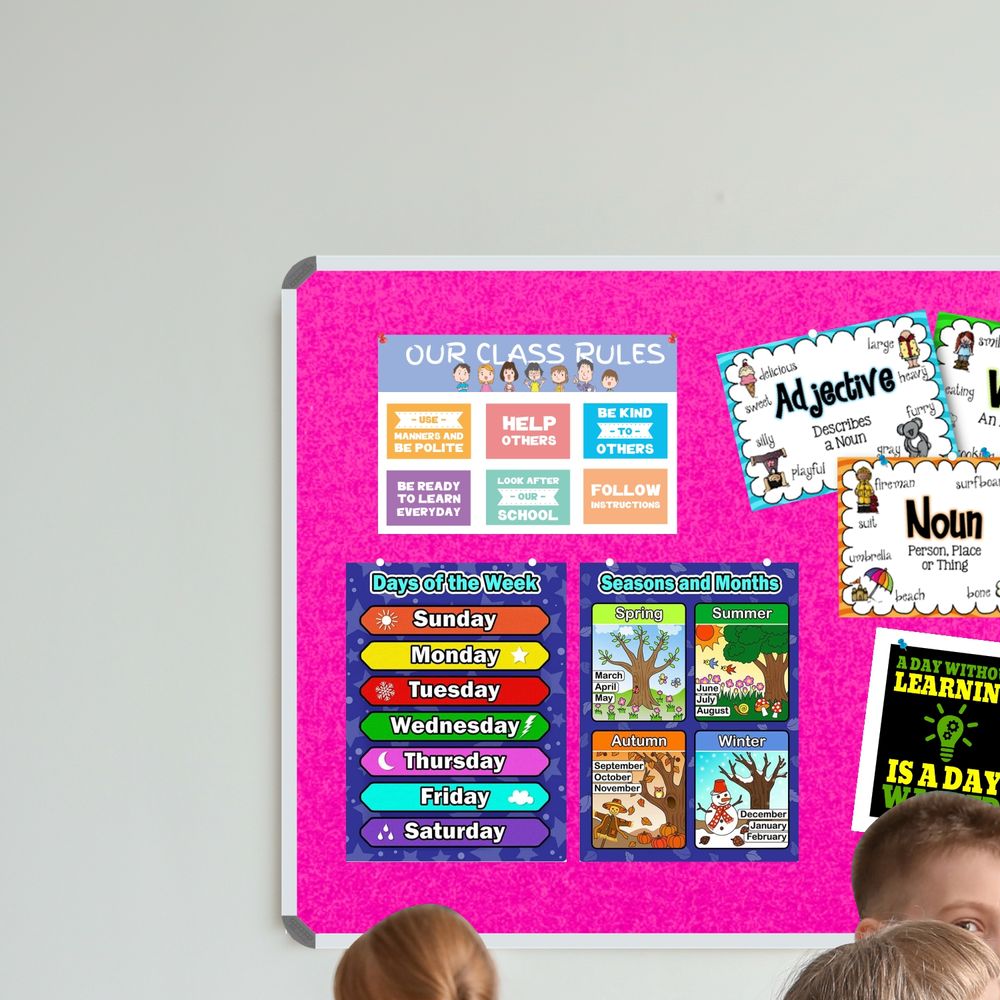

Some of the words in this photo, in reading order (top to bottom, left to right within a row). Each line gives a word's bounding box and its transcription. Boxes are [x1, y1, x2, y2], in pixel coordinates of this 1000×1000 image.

[868, 337, 894, 353] large
[405, 342, 466, 365] OUR
[477, 343, 565, 365] CLASS
[575, 342, 666, 365] RULES
[759, 362, 797, 380] delicious
[898, 368, 928, 383] heavy
[776, 367, 895, 419] Adjective
[945, 383, 975, 402] eating
[745, 397, 772, 414] sweet
[906, 403, 936, 418] furry
[597, 408, 617, 418] BE
[619, 408, 653, 418] KIND
[978, 412, 997, 426] An
[419, 416, 438, 424] USE
[502, 416, 557, 431] HELP
[617, 427, 632, 436] TO
[812, 416, 872, 437] Describes
[394, 432, 441, 441] MANNERS
[443, 432, 464, 441] AND
[501, 435, 557, 446] OTHERS
[756, 433, 774, 448] silly
[825, 442, 833, 451] a
[836, 433, 867, 449] Noun
[394, 443, 413, 453] BE
[415, 443, 464, 453] POLITE
[596, 443, 654, 455] OTHERS
[792, 463, 826, 480] playful
[397, 481, 415, 491] BE
[417, 481, 460, 491] READY
[497, 477, 524, 485] LOOK
[526, 477, 559, 485] AFTER
[875, 478, 915, 490] fireman
[518, 492, 538, 501] OUR
[591, 484, 661, 497] FOLLOW
[398, 494, 415, 503] TO
[418, 494, 461, 503] LEARN
[591, 501, 660, 509] INSTRUCTIONS
[396, 507, 461, 517] EVERYDAY
[497, 510, 558, 521] SCHOOL
[906, 496, 983, 539] Noun
[859, 516, 877, 528] suit
[849, 549, 892, 563] umbrella
[908, 545, 949, 558] Person,
[952, 545, 981, 556] Place
[922, 561, 934, 570] or
[937, 559, 968, 572] Thing
[371, 573, 419, 595] Days
[423, 573, 444, 592] of
[448, 573, 480, 592] the
[483, 573, 539, 592] Week
[600, 573, 675, 592] Seasons
[678, 573, 712, 592] and
[715, 573, 780, 592] Months
[896, 588, 925, 601] beach
[967, 587, 990, 598] bone
[615, 607, 663, 622] Spring
[712, 607, 772, 619] Summer
[413, 609, 497, 631] Sunday
[410, 645, 500, 667] Monday
[896, 655, 907, 670] A
[910, 657, 943, 674] DAY
[595, 671, 623, 680] March
[408, 680, 501, 702] Tuesday
[595, 683, 616, 692] April
[697, 685, 718, 693] June
[595, 695, 613, 703] May
[697, 696, 715, 705] July
[697, 707, 729, 716] August
[390, 716, 520, 738] Wednesday
[611, 735, 667, 747] Autumn
[718, 735, 766, 747] Winter
[403, 751, 506, 773] Thursday
[594, 762, 644, 772] September
[594, 773, 631, 781] October
[886, 759, 914, 785] IS
[917, 763, 938, 788] A
[594, 784, 641, 792] November
[420, 786, 490, 809] Friday
[740, 810, 787, 818] December
[404, 821, 506, 844] Saturday
[750, 822, 787, 831] January
[747, 833, 787, 842] February
